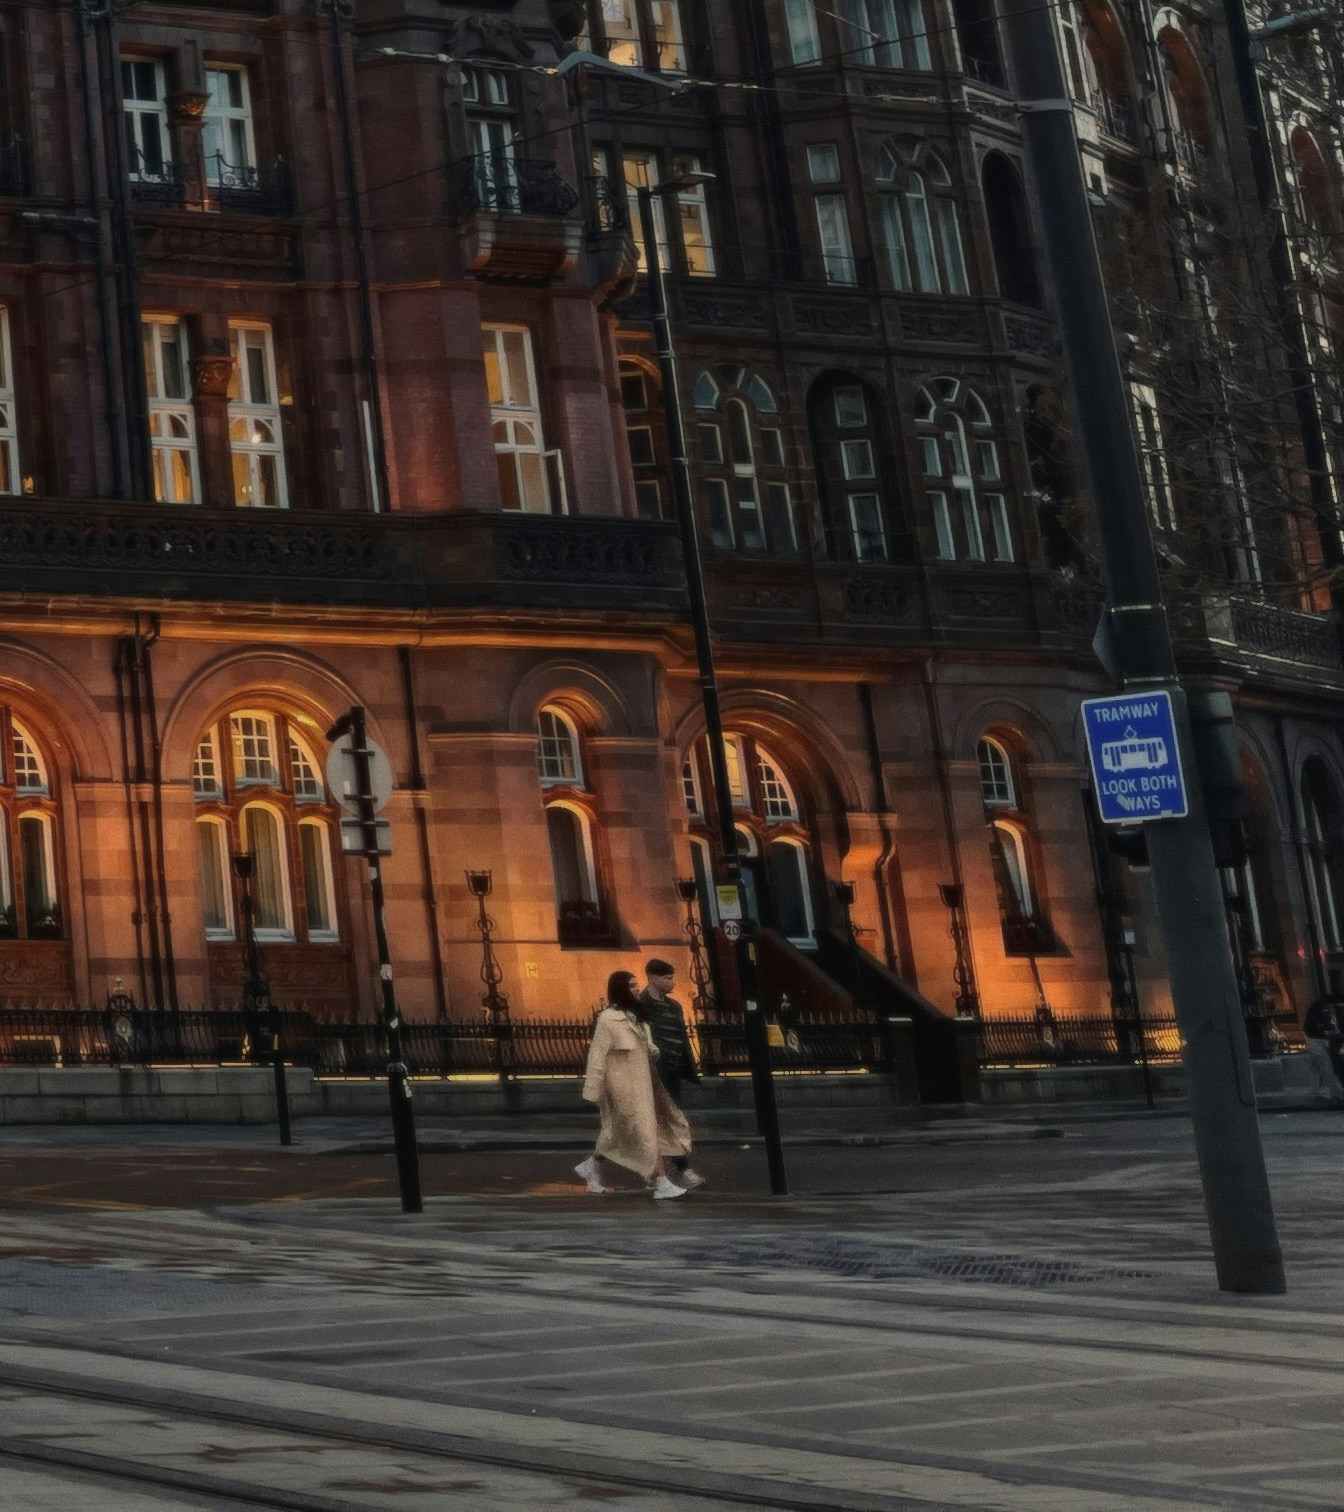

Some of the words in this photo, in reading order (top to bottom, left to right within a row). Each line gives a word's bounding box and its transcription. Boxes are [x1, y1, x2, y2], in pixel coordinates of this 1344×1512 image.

[1093, 701, 1159, 724] TRAMWAY
[1102, 778, 1138, 796] LOOK
[1140, 774, 1178, 792] BOTH
[725, 925, 739, 936] 20
